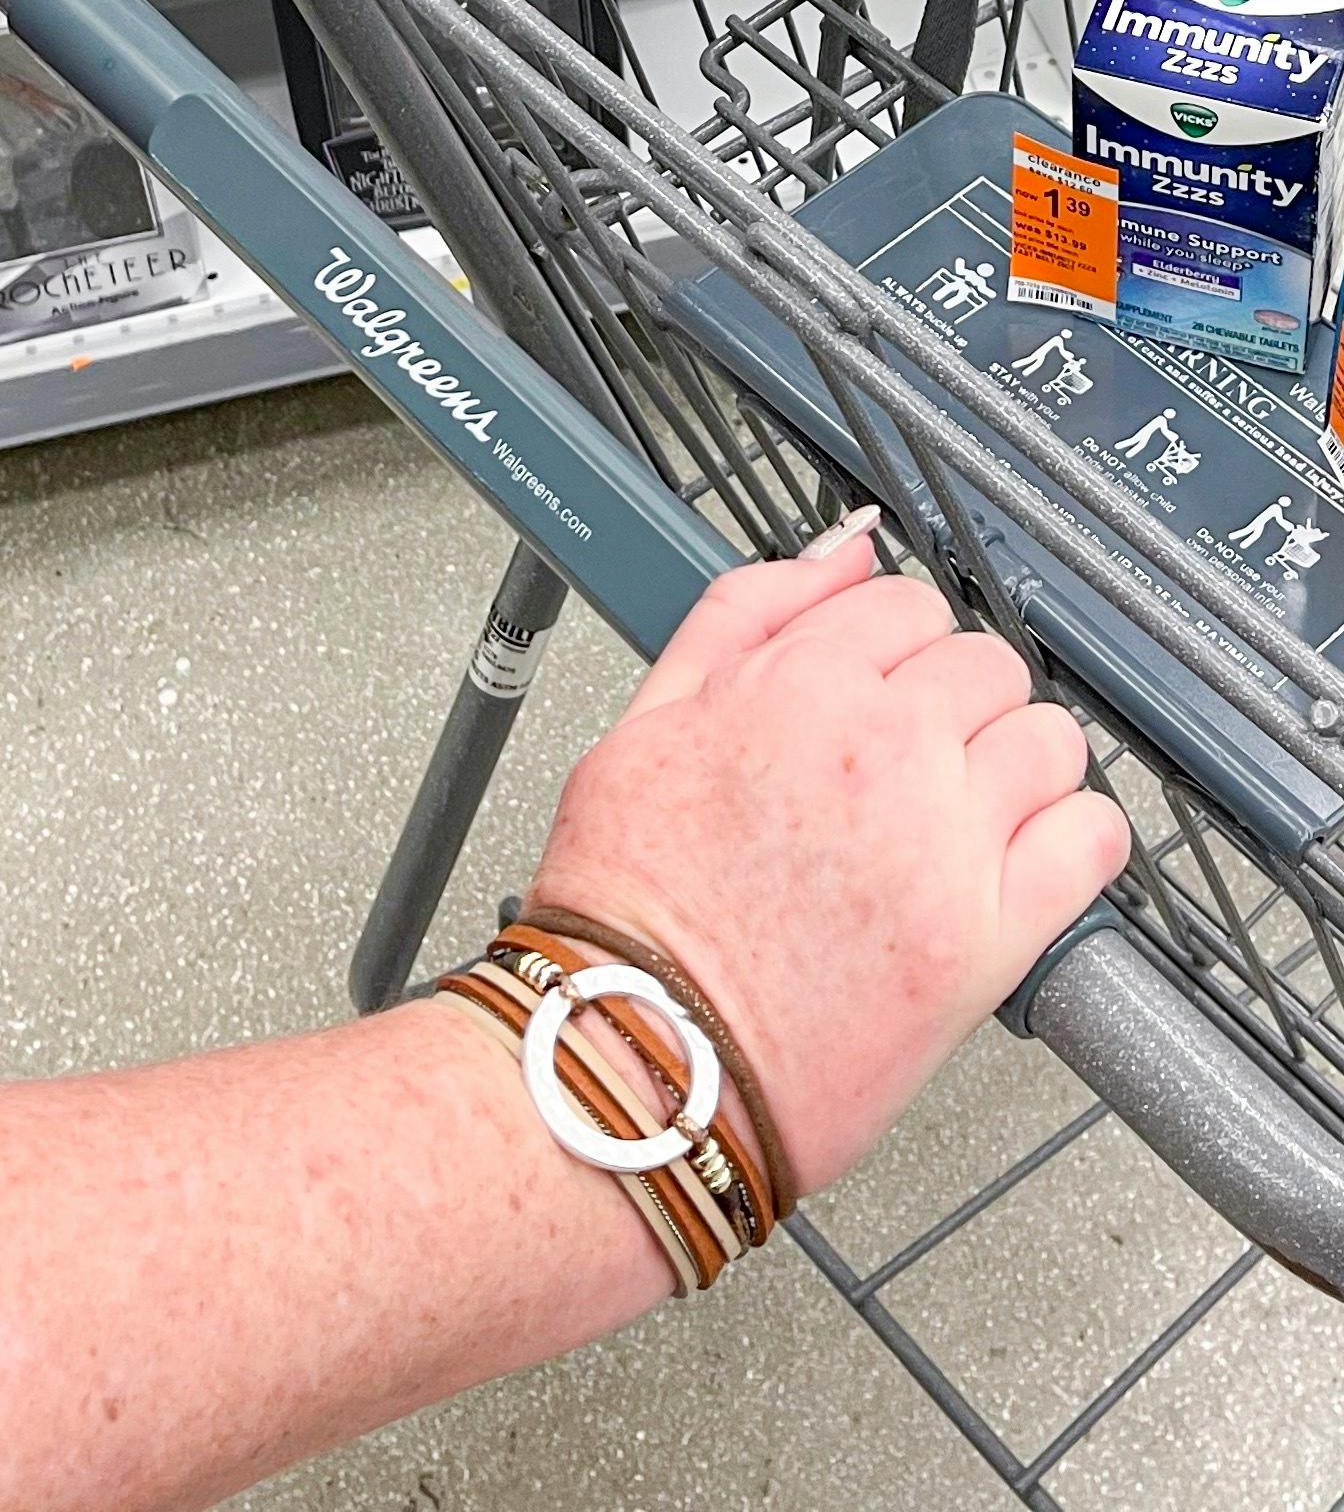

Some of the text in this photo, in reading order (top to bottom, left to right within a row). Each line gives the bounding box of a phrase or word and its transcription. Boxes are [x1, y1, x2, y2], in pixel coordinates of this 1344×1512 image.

[1160, 48, 1240, 85] Zzzs
[1027, 154, 1101, 188] clearance
[1086, 124, 1304, 208] Immunity
[1015, 187, 1039, 202] now
[1152, 174, 1225, 207] Zzzs
[1015, 221, 1042, 235] was
[1119, 218, 1283, 267] mune Support
[1120, 233, 1162, 252] while
[1164, 245, 1195, 260] you
[1152, 259, 1220, 285] Elderberry
[51, 296, 97, 317] Action
[881, 276, 969, 348] ALWAYS buckle up
[314, 247, 498, 443] Walgreens
[1206, 323, 1257, 344] CHEWABLE
[1258, 336, 1300, 354] TABLETS
[989, 362, 1061, 422] STAY with your
[1128, 333, 1141, 348] of
[1140, 346, 1166, 368] cart
[1164, 363, 1190, 385] and
[1187, 379, 1223, 410] suffer
[1232, 413, 1275, 448] serious
[1275, 444, 1307, 476] head
[492, 438, 593, 542] Walgreens.com
[1082, 436, 1178, 514] Do NOT allow child
[1196, 527, 1287, 601] Do NOT use your
[1254, 589, 1287, 619] infant
